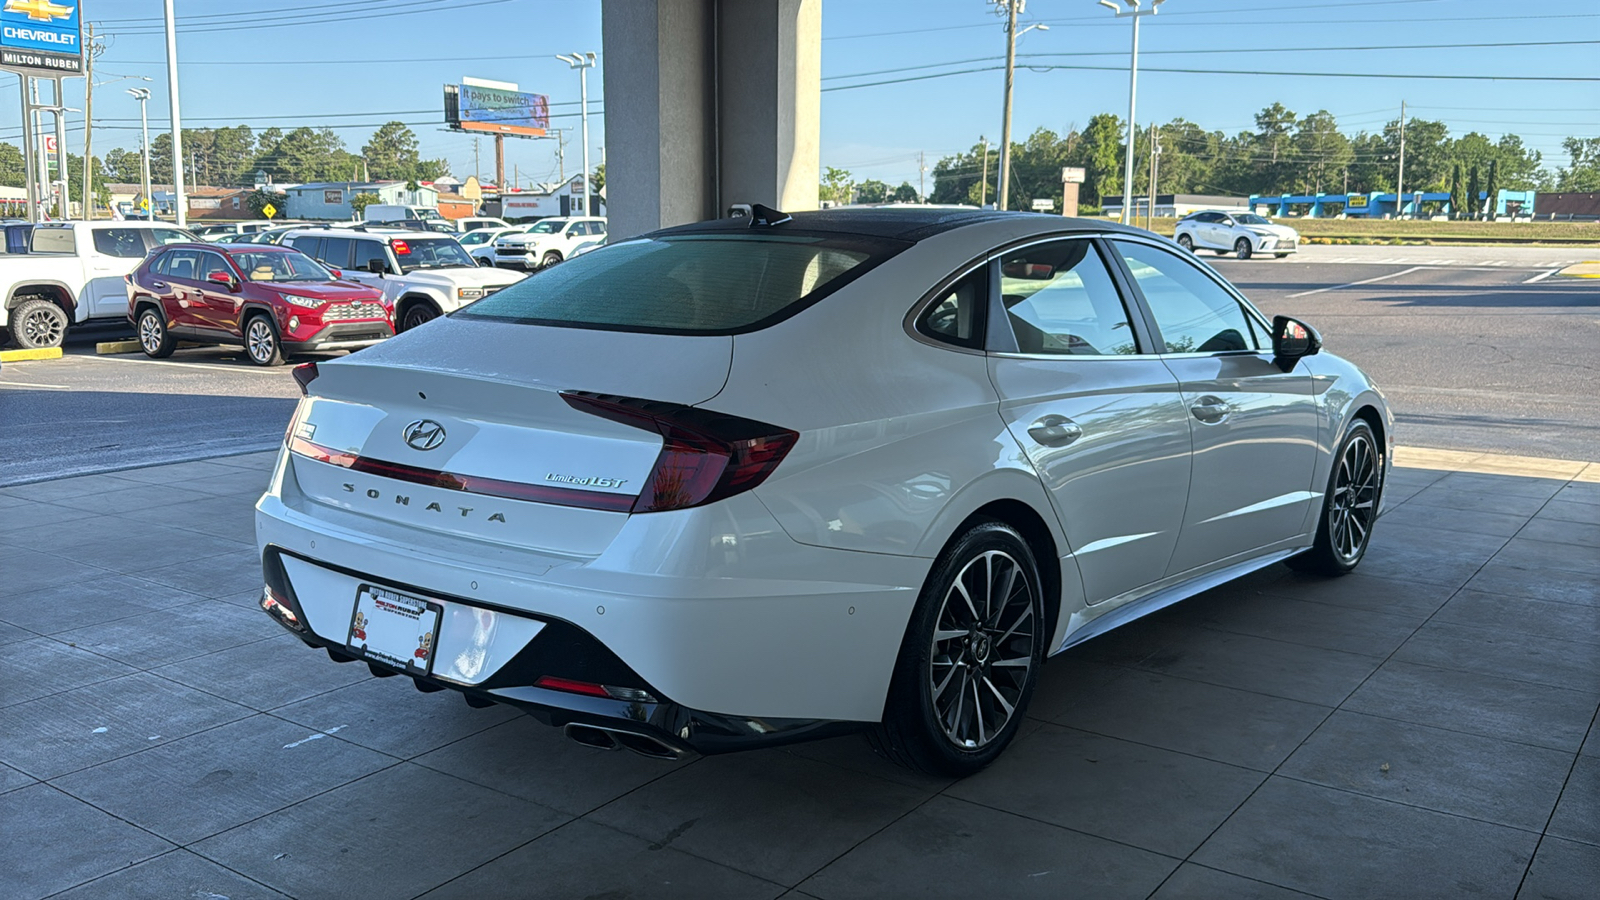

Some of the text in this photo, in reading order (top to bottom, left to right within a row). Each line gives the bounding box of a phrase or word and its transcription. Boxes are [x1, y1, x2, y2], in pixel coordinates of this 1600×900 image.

[4, 27, 76, 45] CHEVROLET
[4, 53, 79, 69] MILTON RUBEN
[463, 88, 530, 105] It pays to switch
[545, 472, 590, 485] Limited
[342, 482, 506, 524] SONATA
[375, 599, 421, 616] MILTON RUBEN
